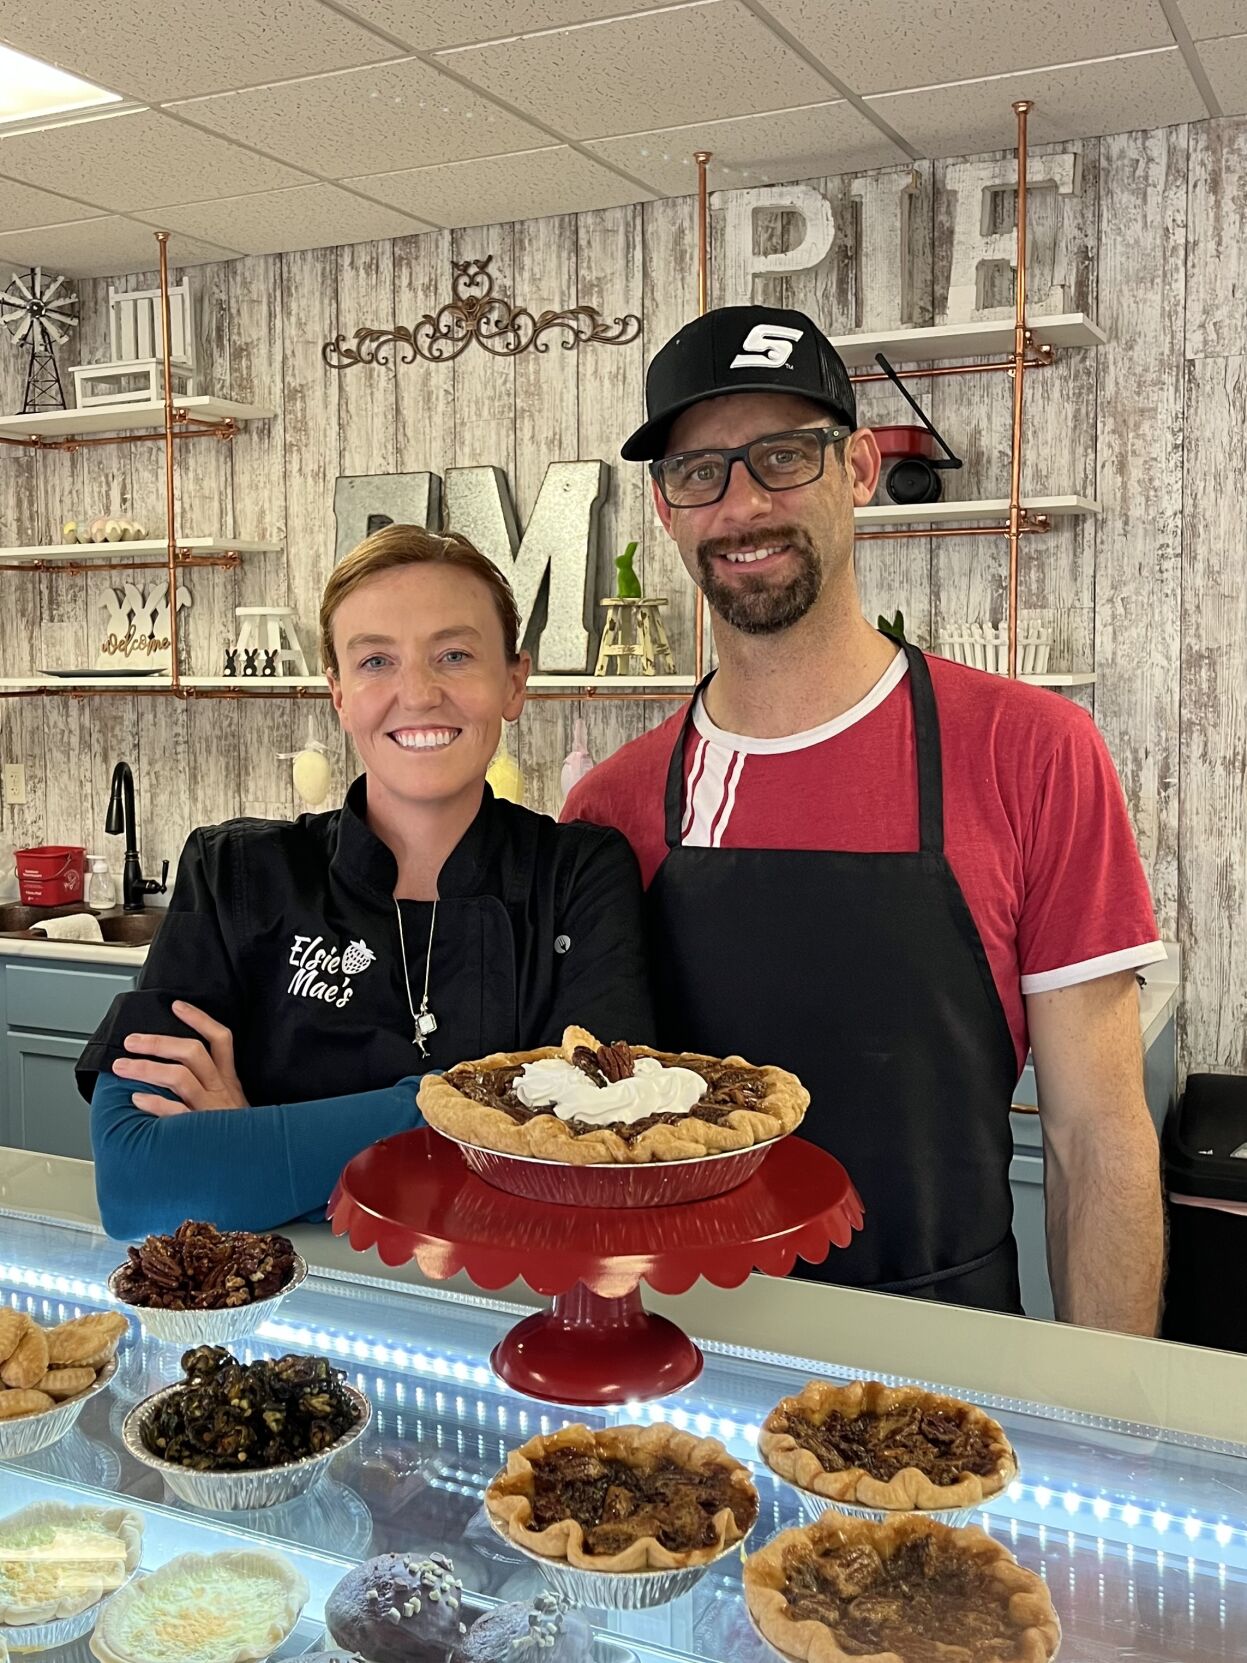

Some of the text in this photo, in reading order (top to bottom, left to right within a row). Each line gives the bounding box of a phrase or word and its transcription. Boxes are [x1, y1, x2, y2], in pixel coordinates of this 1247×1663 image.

[710, 153, 1080, 327] PIE
[101, 624, 171, 657] welcome
[289, 935, 341, 975] Elsie
[287, 967, 354, 1008] Mae's
